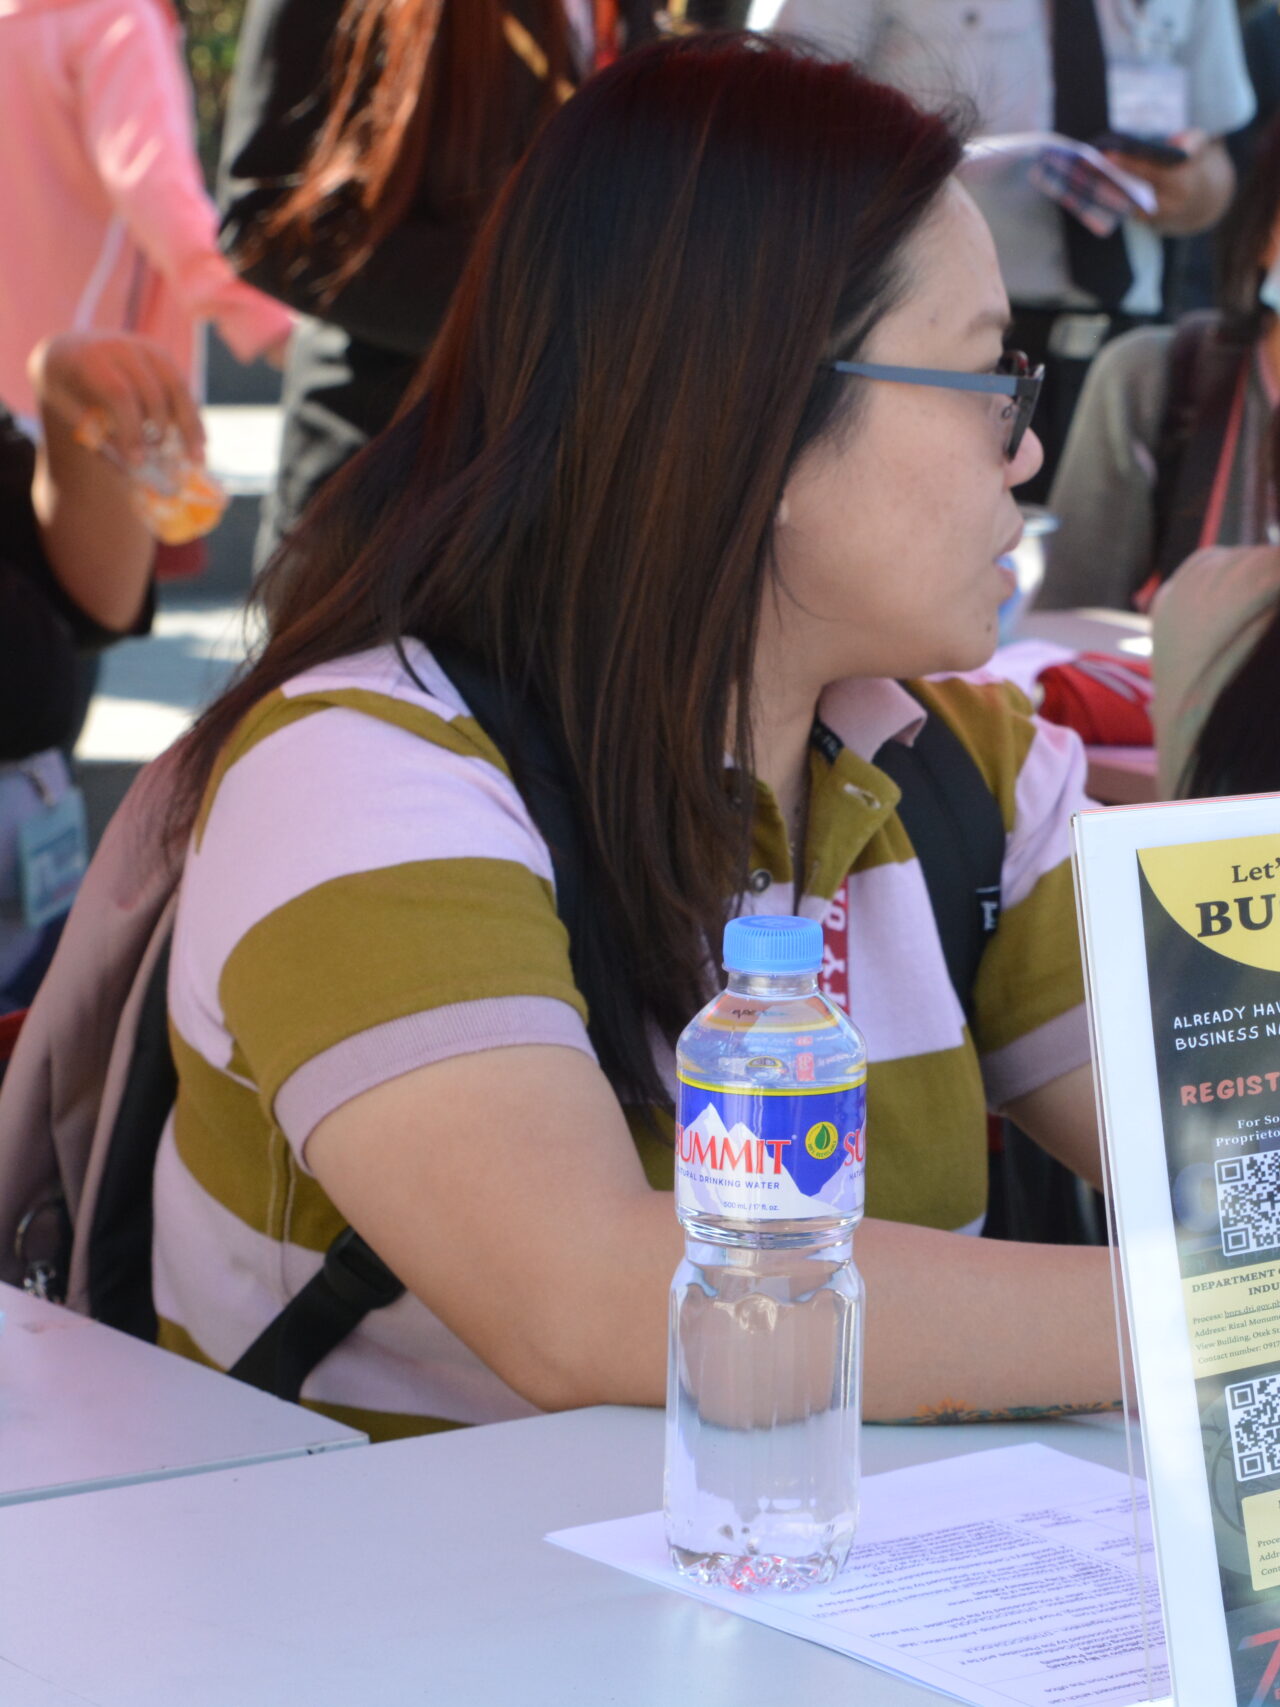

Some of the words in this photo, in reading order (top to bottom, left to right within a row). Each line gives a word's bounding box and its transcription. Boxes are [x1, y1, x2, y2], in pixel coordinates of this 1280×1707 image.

[1172, 1005, 1246, 1029] ALREADY
[1175, 1024, 1259, 1051] BUSINESS
[1237, 1116, 1260, 1129] For
[700, 1174, 741, 1188] DRINKING
[746, 1181, 780, 1190] WATER
[1191, 1268, 1275, 1293] DEPARTMENT
[1192, 1311, 1223, 1325] Process:
[1193, 1323, 1227, 1338] Address:
[1228, 1319, 1247, 1331] Rizal
[1216, 1332, 1251, 1348] Building,
[1252, 1328, 1271, 1340] Otek
[1198, 1351, 1227, 1365] Contact
[1228, 1344, 1261, 1358] number:
